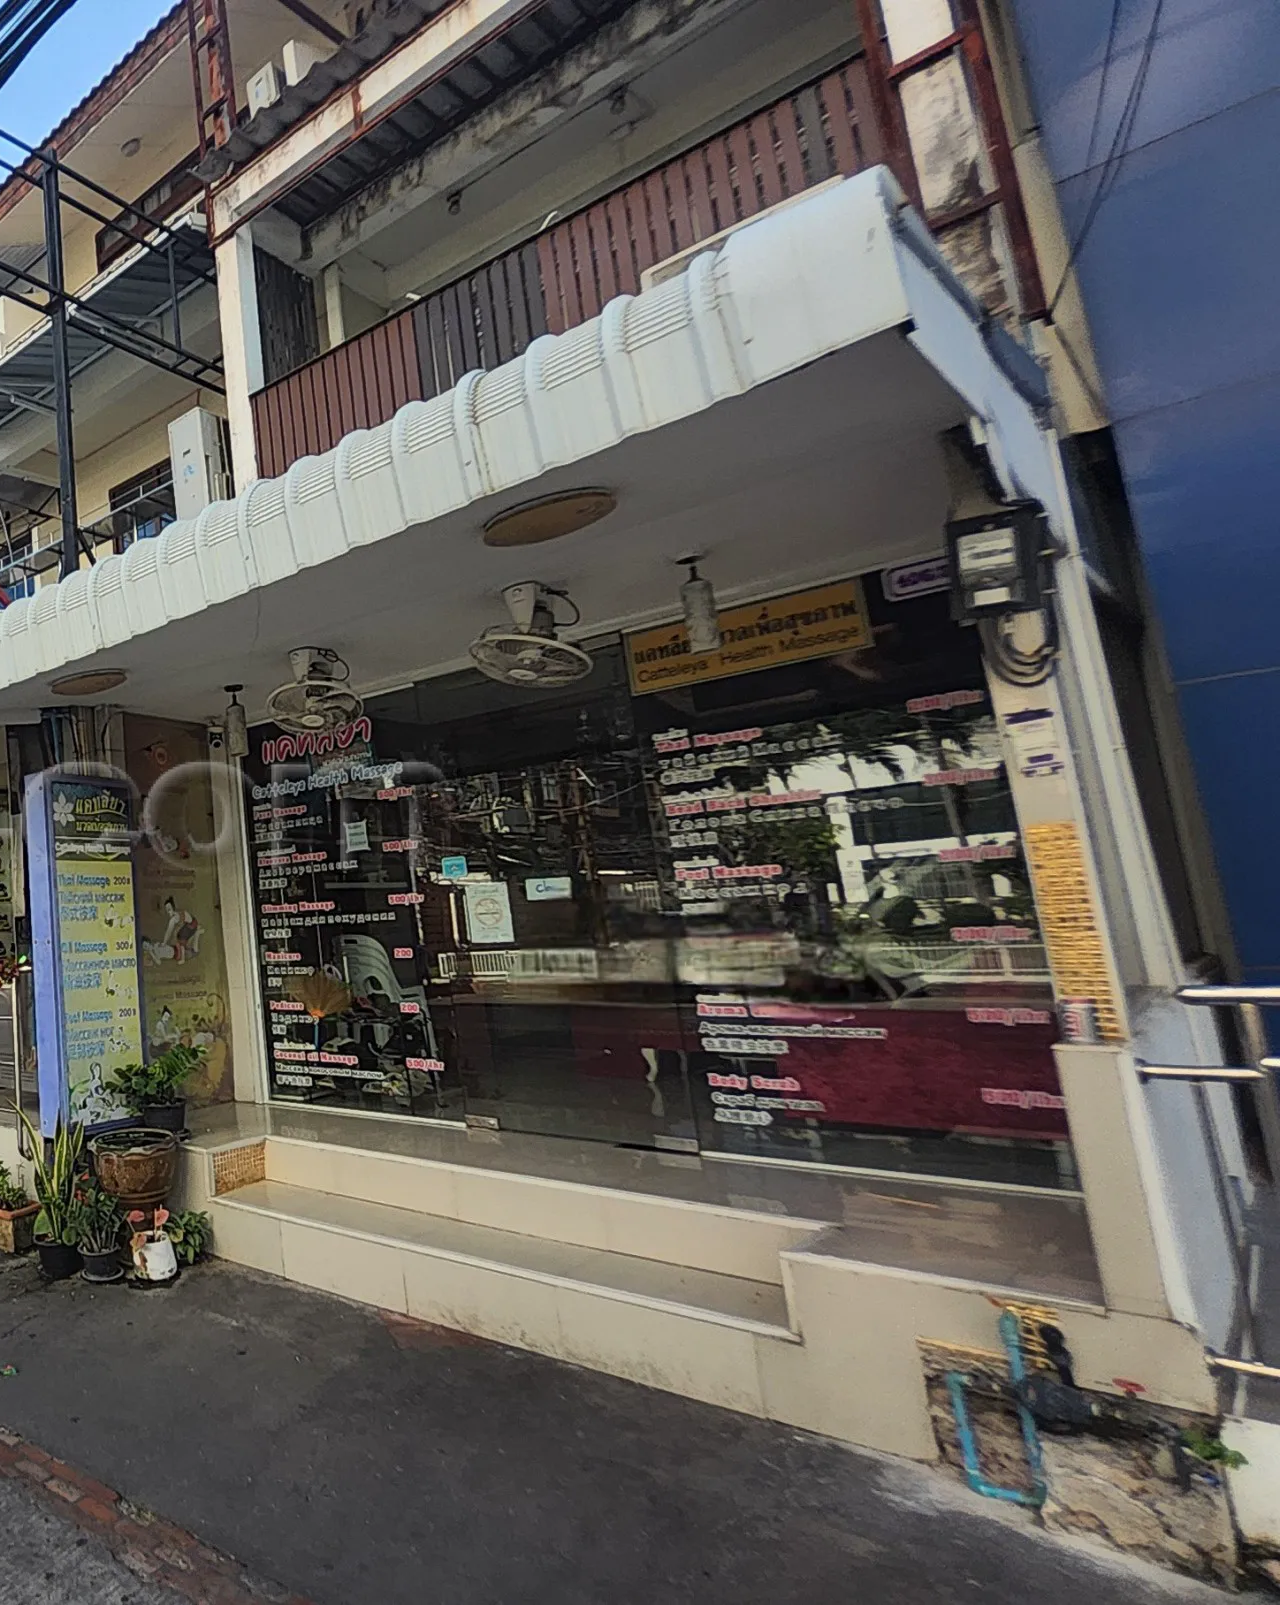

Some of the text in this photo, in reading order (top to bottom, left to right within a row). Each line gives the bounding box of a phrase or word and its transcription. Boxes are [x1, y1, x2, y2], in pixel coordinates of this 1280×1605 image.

[778, 625, 860, 653] Massage
[308, 769, 349, 791] Health
[350, 761, 404, 781] Massage
[76, 875, 111, 888] Massage
[74, 941, 108, 955] Massage
[81, 1010, 113, 1023] Massage
[320, 1052, 359, 1066] Massage
